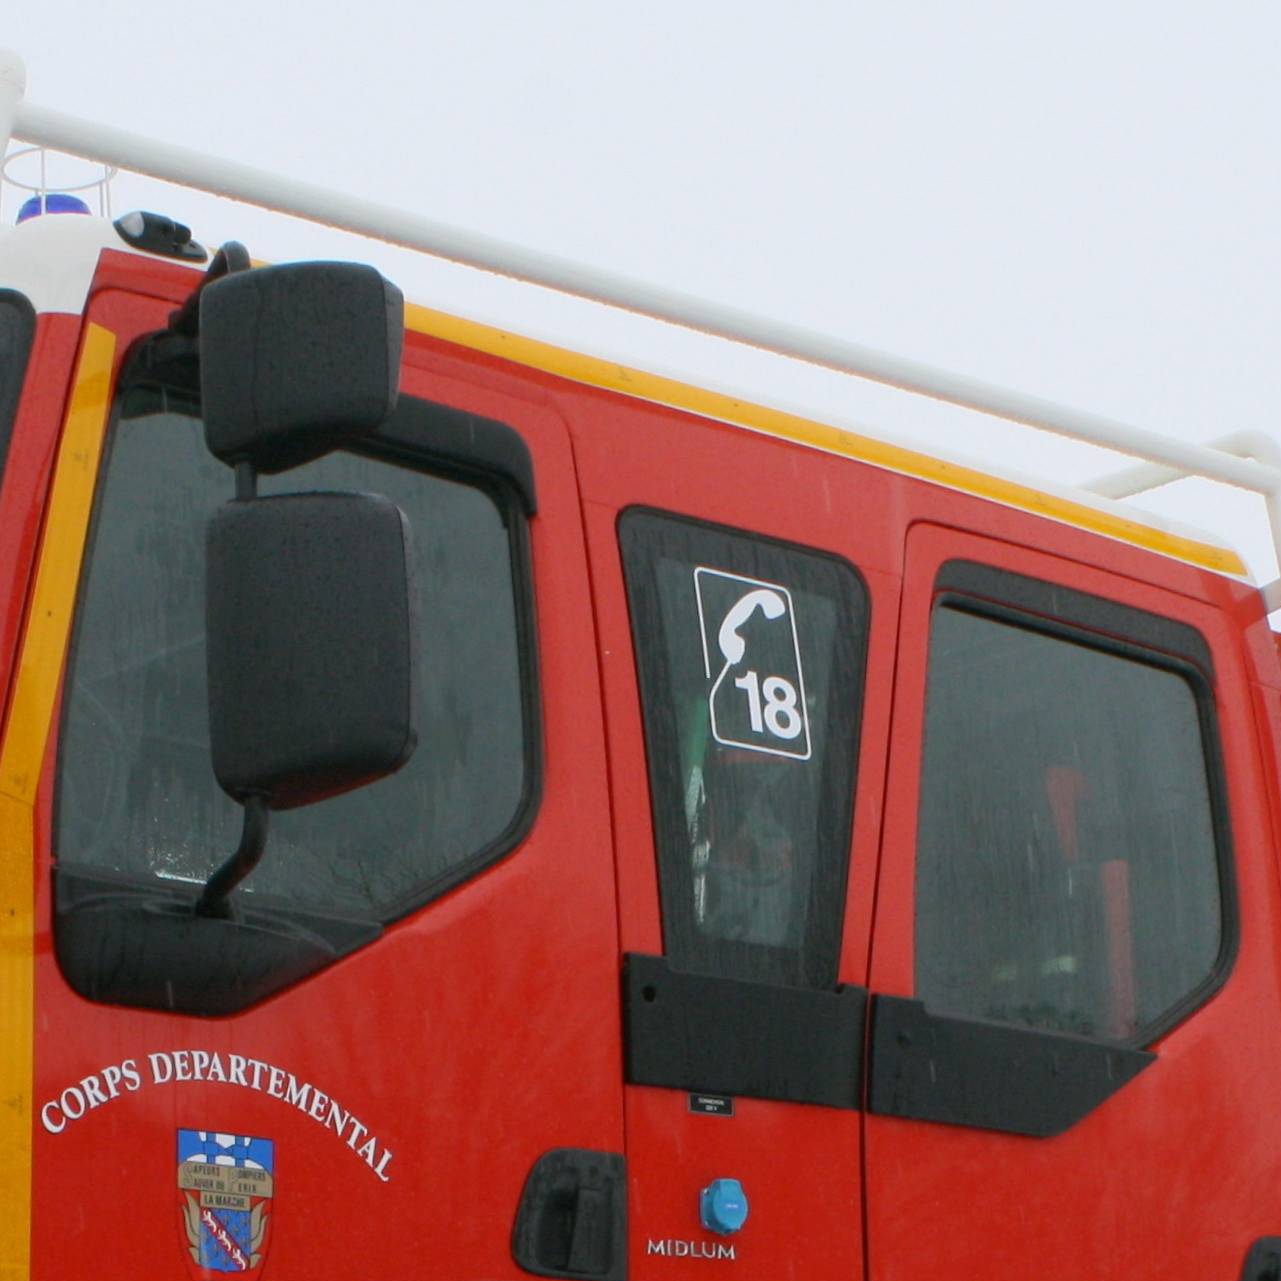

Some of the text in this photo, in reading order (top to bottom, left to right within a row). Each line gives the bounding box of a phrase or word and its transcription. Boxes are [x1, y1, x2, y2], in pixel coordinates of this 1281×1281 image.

[735, 670, 802, 739] 18
[41, 1049, 400, 1183] CORPS DEPARTEMENTAL
[647, 1239, 736, 1260] MIDLUM
